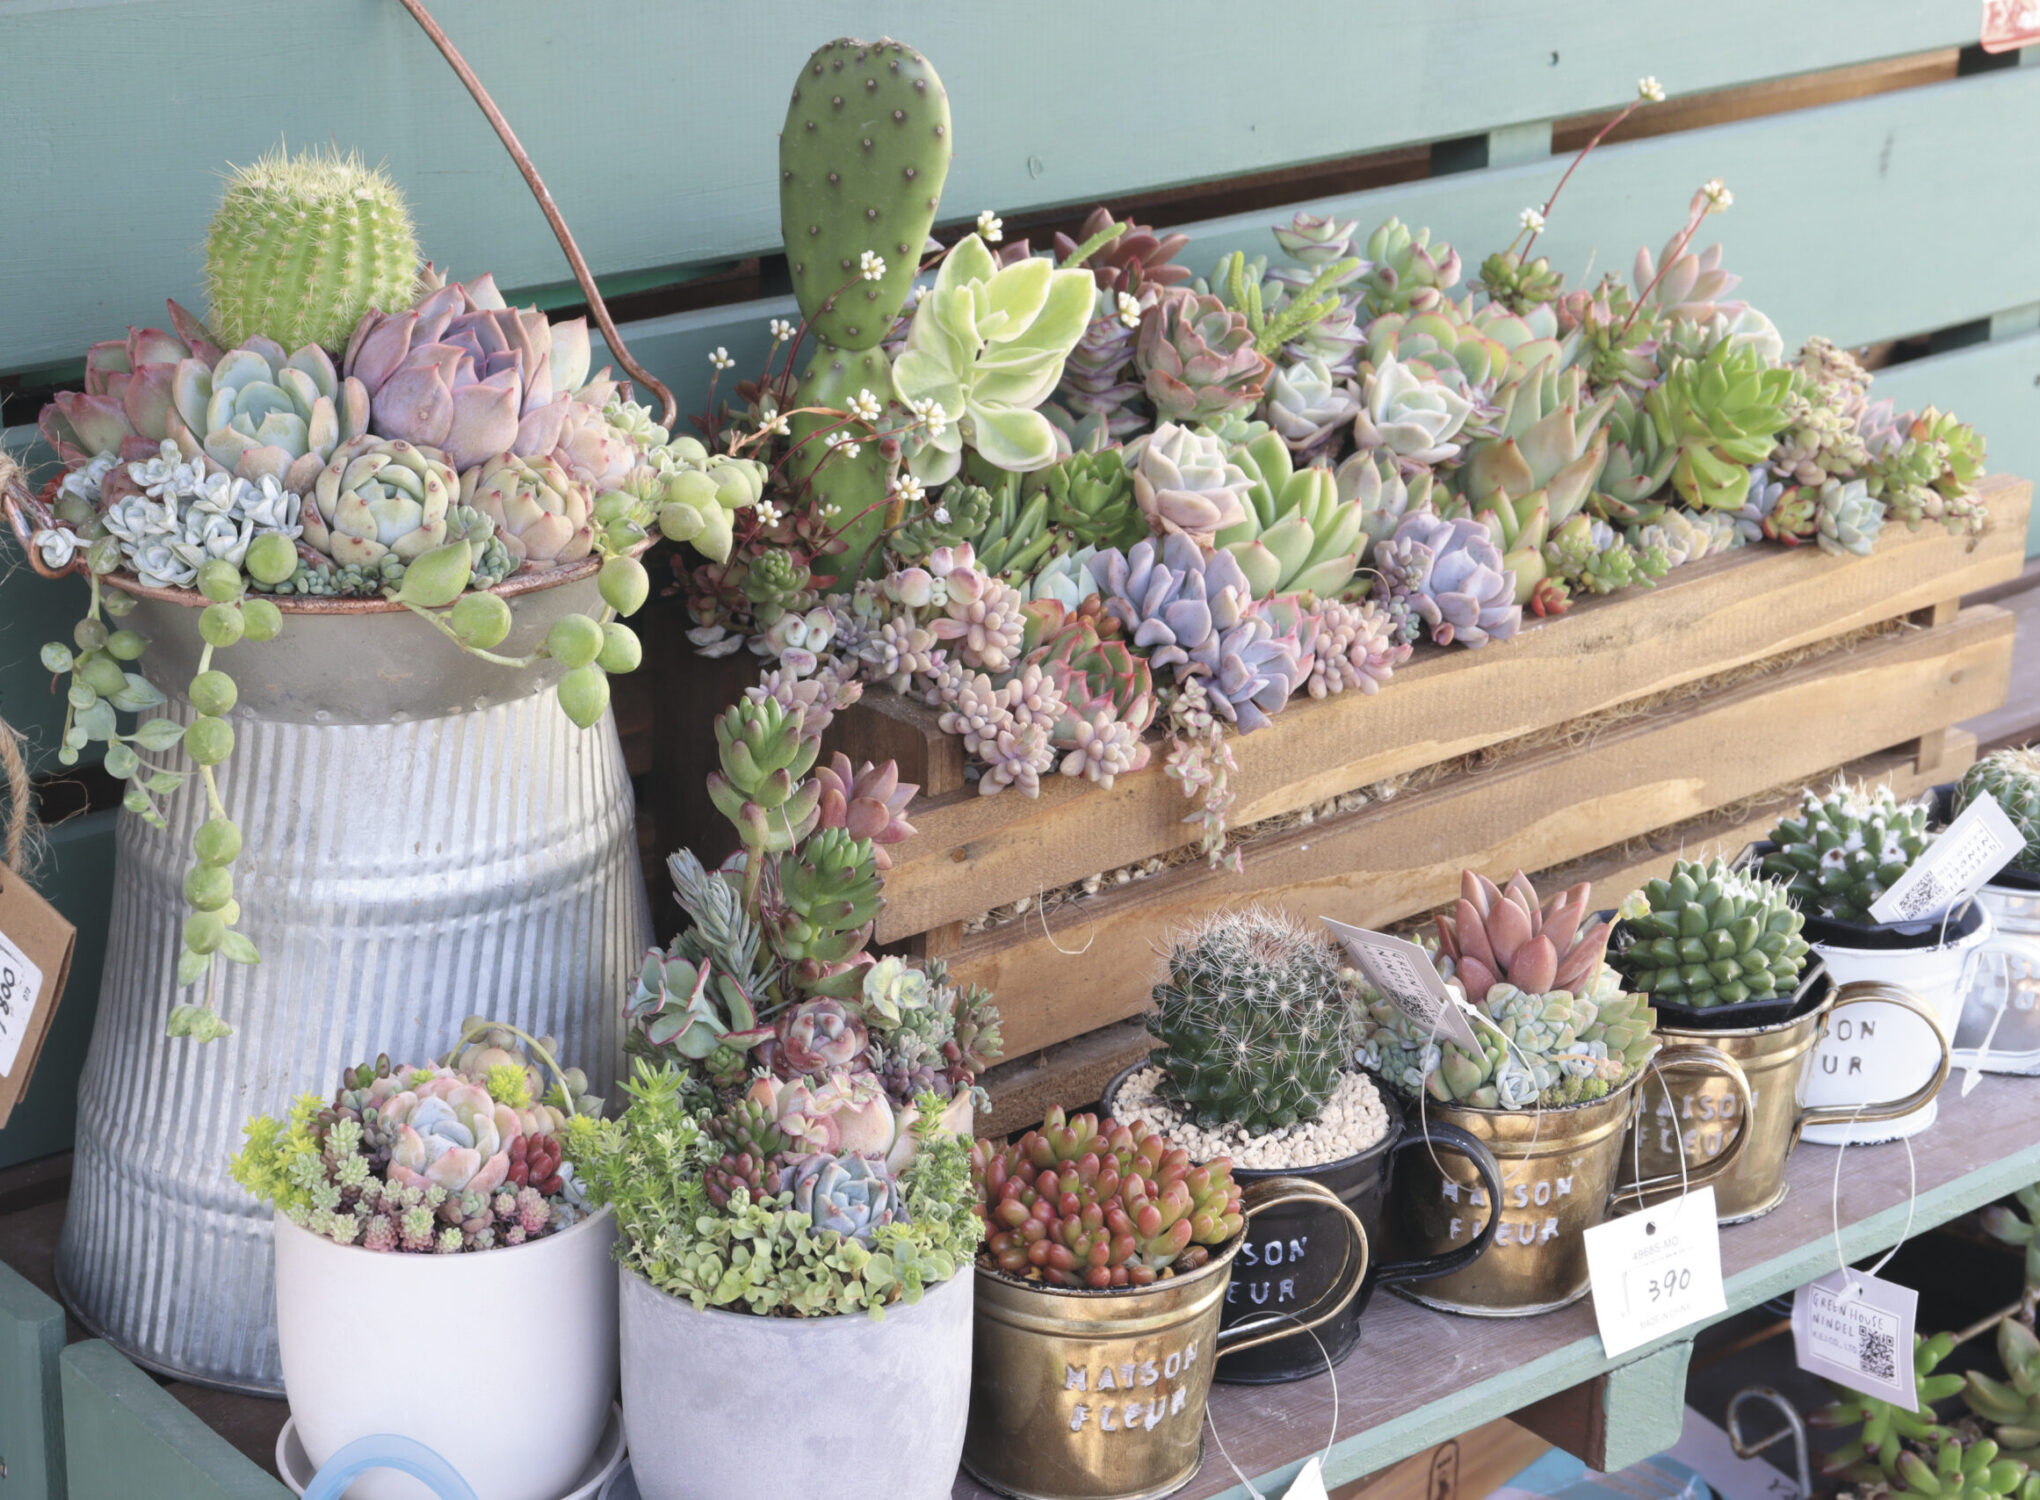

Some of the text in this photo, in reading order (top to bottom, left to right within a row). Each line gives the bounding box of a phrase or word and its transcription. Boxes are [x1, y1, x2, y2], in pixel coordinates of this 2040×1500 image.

[1822, 1019, 1876, 1041] ON
[1442, 1175, 1573, 1208] MASON
[1233, 1236, 1308, 1266] SON
[1225, 1278, 1296, 1305] EUR
[1648, 1267, 1692, 1302] 390
[1811, 1313, 1856, 1338] NINDEL
[1849, 1308, 1884, 1331] HOUSE
[1065, 1339, 1199, 1392] MAISON
[1070, 1384, 1187, 1432] FLEUR
